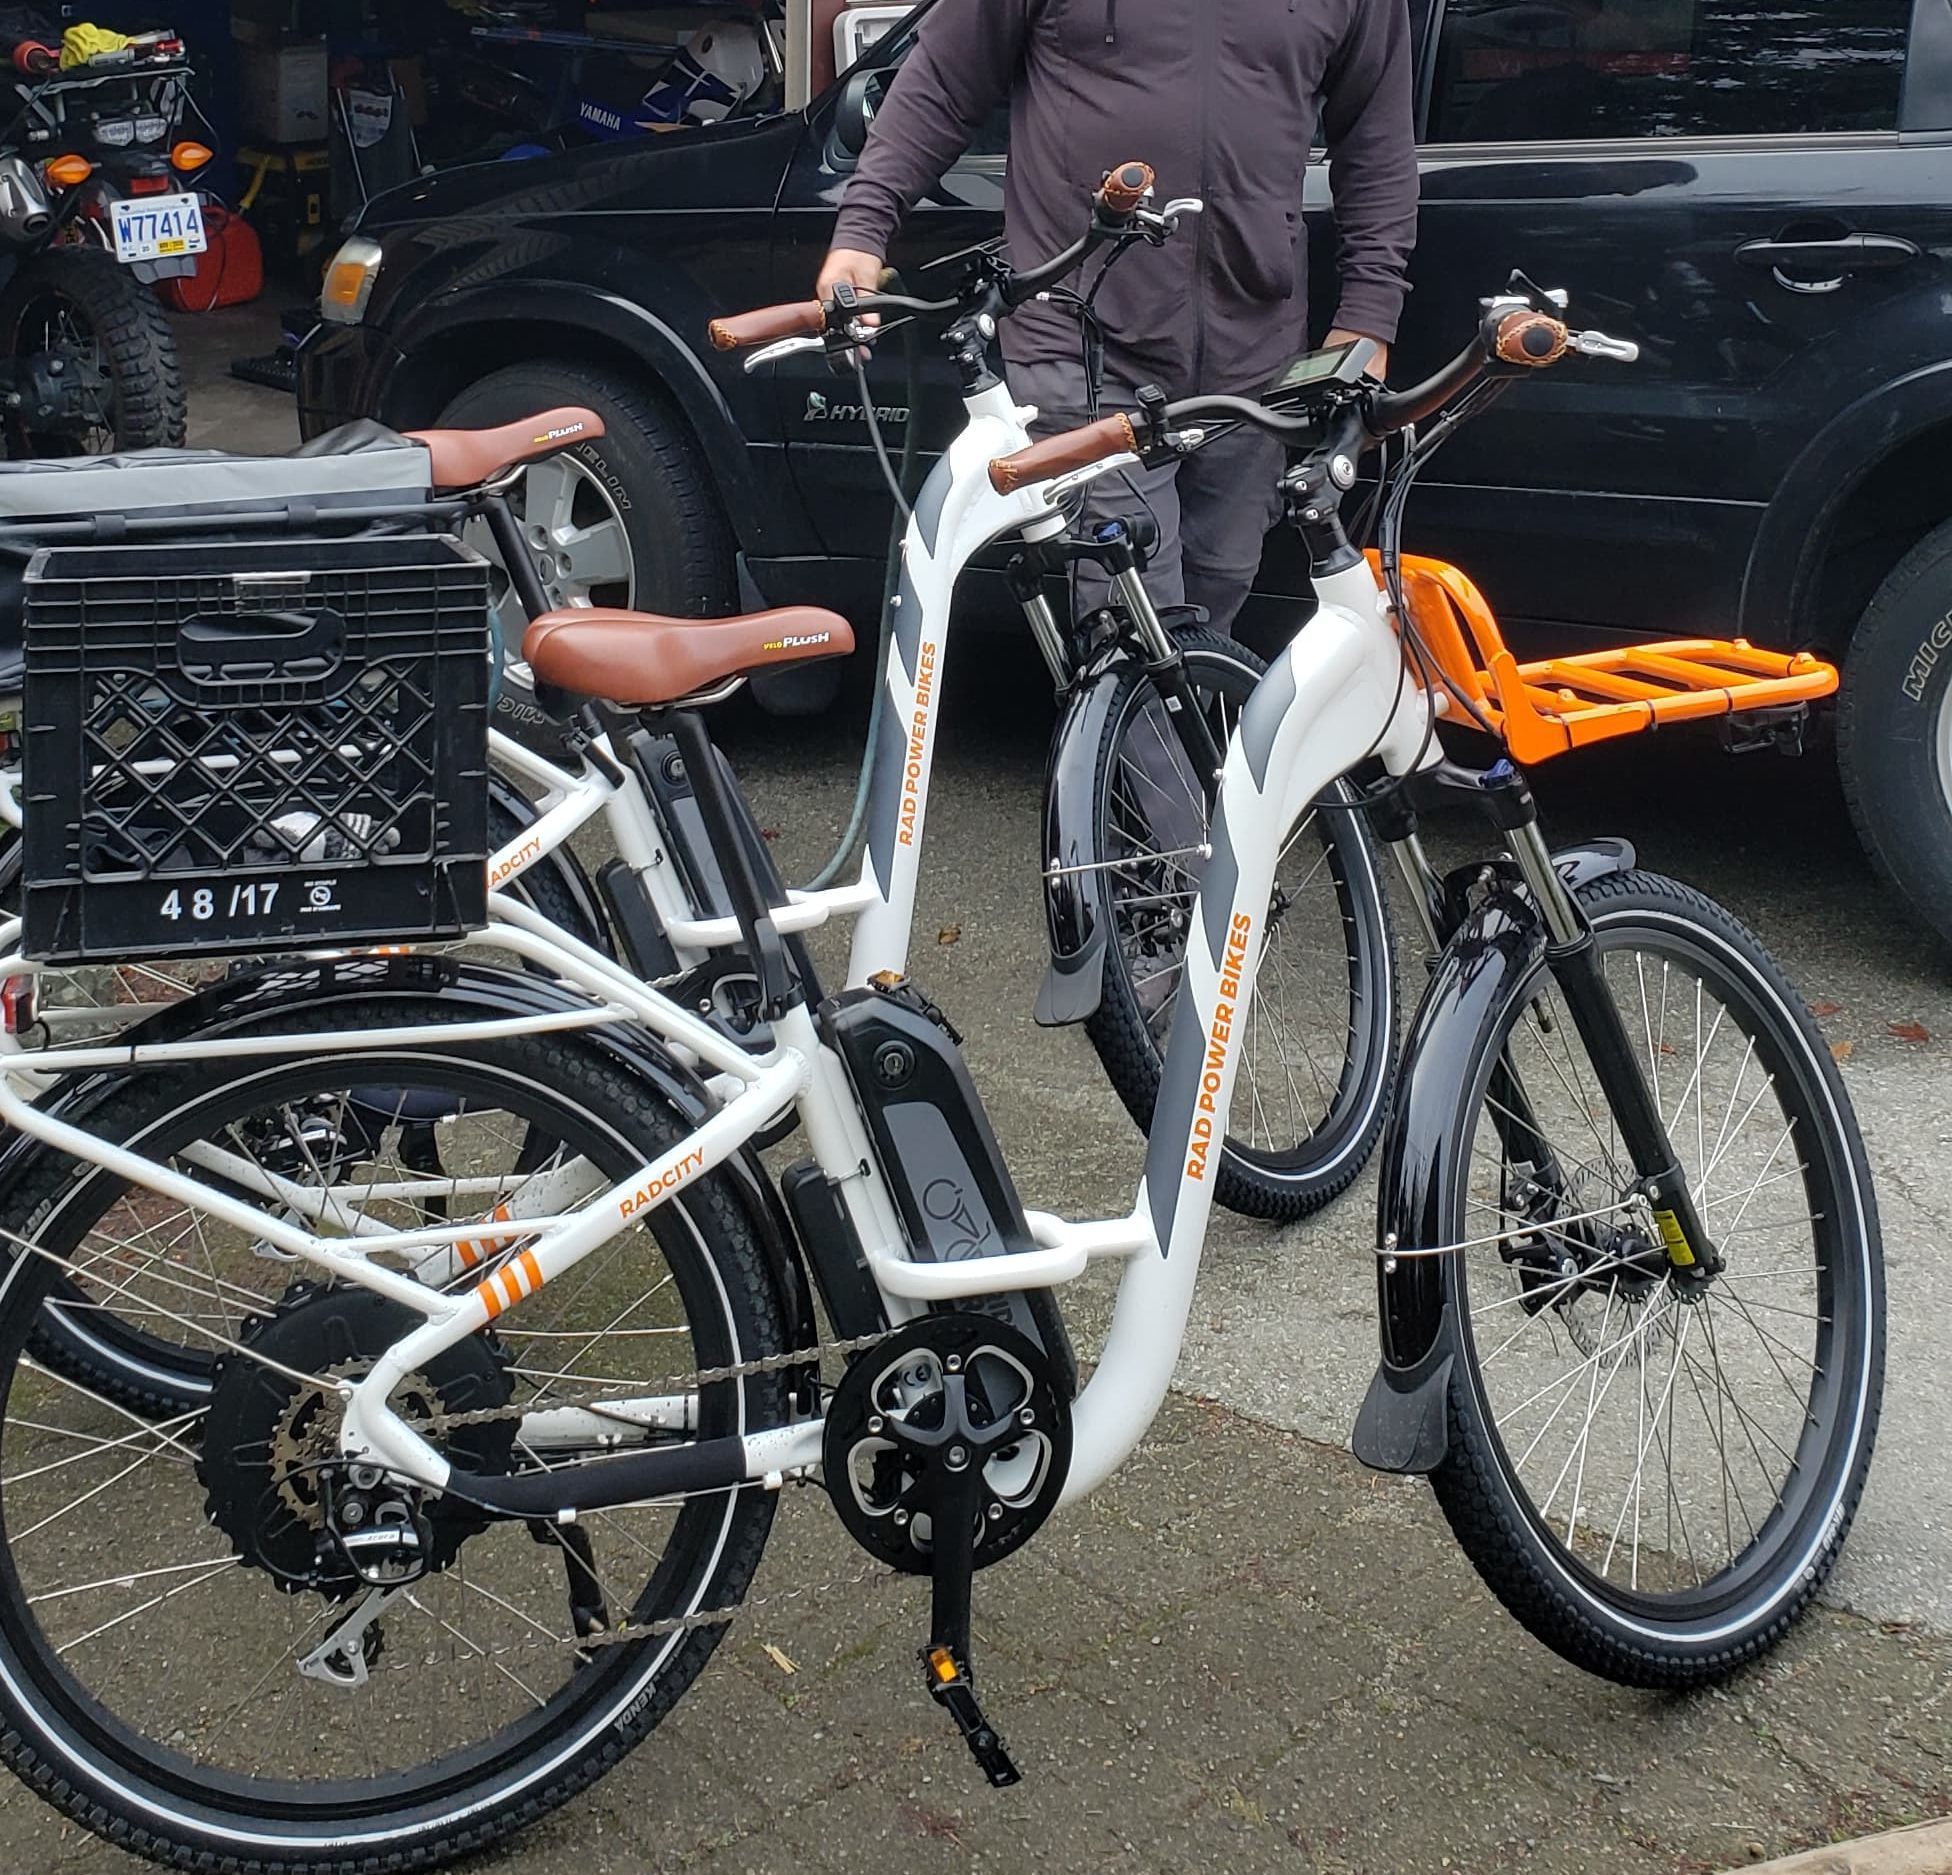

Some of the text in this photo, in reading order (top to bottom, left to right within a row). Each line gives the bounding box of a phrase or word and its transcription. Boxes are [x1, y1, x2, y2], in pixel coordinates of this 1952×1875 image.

[580, 101, 621, 131] YAMAHA
[118, 209, 199, 243] W77414
[783, 632, 830, 648] PLUSH
[497, 693, 545, 724] MIC
[899, 641, 936, 846] RAD POWER BIKES
[487, 836, 541, 888] ADCITY
[1186, 912, 1251, 1181] RAD POWER BIKES
[619, 1146, 704, 1219] RADCITY
[613, 1681, 657, 1733] KENDA
